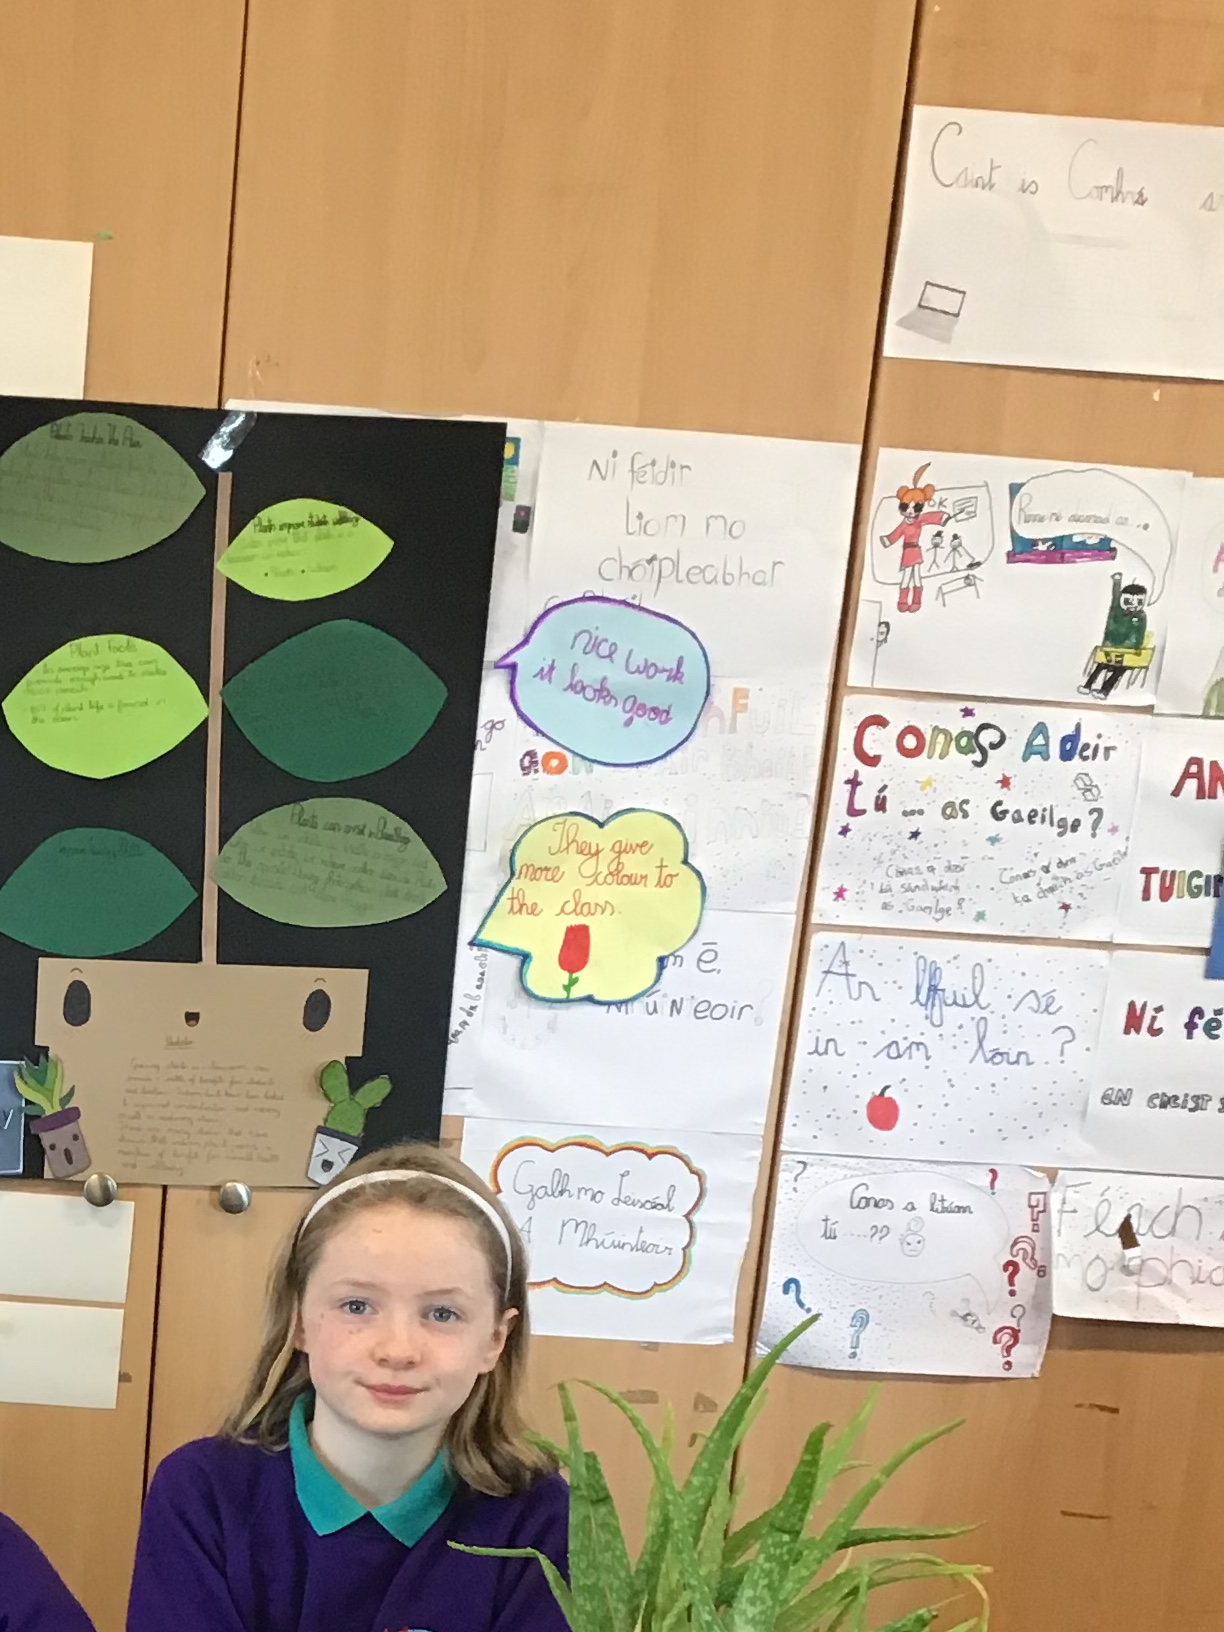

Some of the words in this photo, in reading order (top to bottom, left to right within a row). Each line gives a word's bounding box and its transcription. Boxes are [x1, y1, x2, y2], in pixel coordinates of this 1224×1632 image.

[625, 648, 685, 686] work
[532, 657, 557, 685] it
[622, 694, 674, 728] good
[608, 838, 655, 871] give
[516, 862, 565, 885] more
[654, 857, 680, 890] to
[507, 886, 544, 917] the
